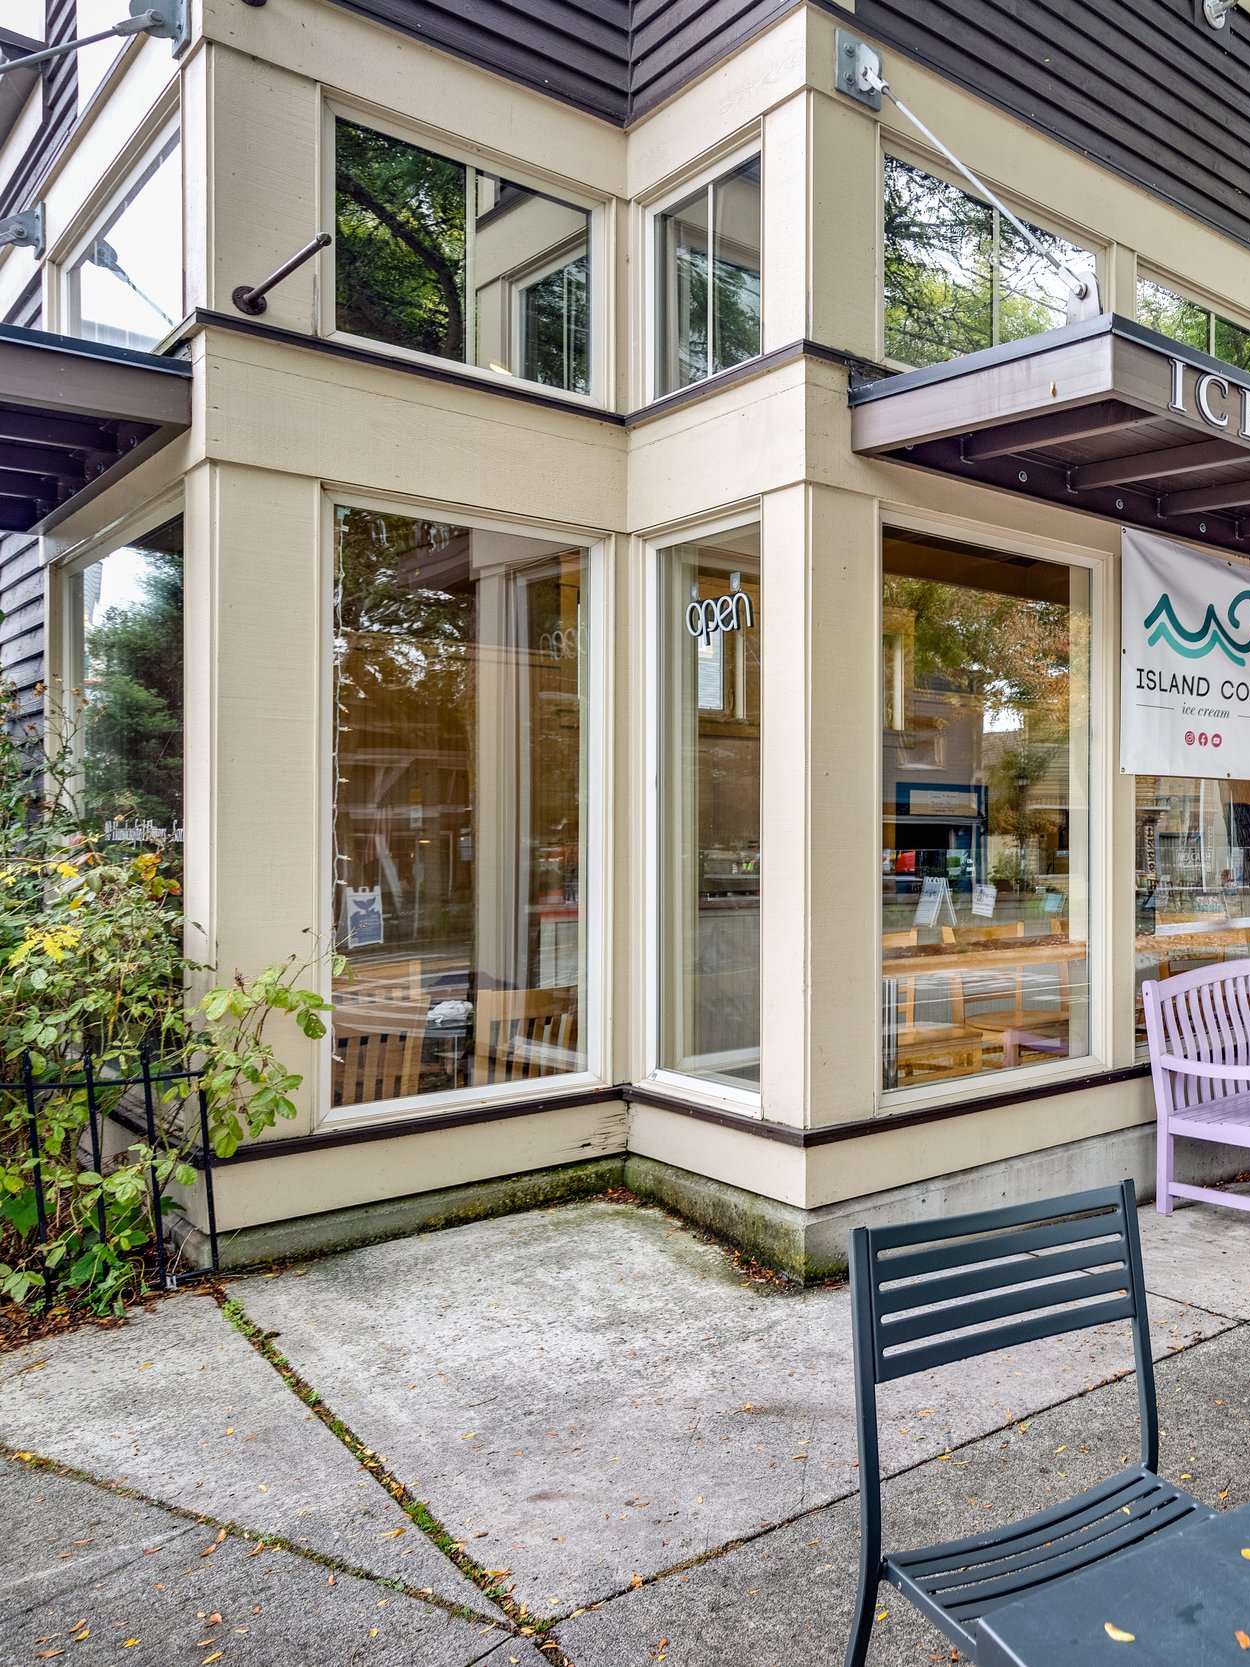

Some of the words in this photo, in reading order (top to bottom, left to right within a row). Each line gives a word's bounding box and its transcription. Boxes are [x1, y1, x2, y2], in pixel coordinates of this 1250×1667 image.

[686, 592, 754, 646] open
[1136, 668, 1210, 697] ISLAND
[1181, 701, 1196, 716] ice
[1197, 706, 1230, 719] cream
[1190, 851, 1212, 861] CAH
